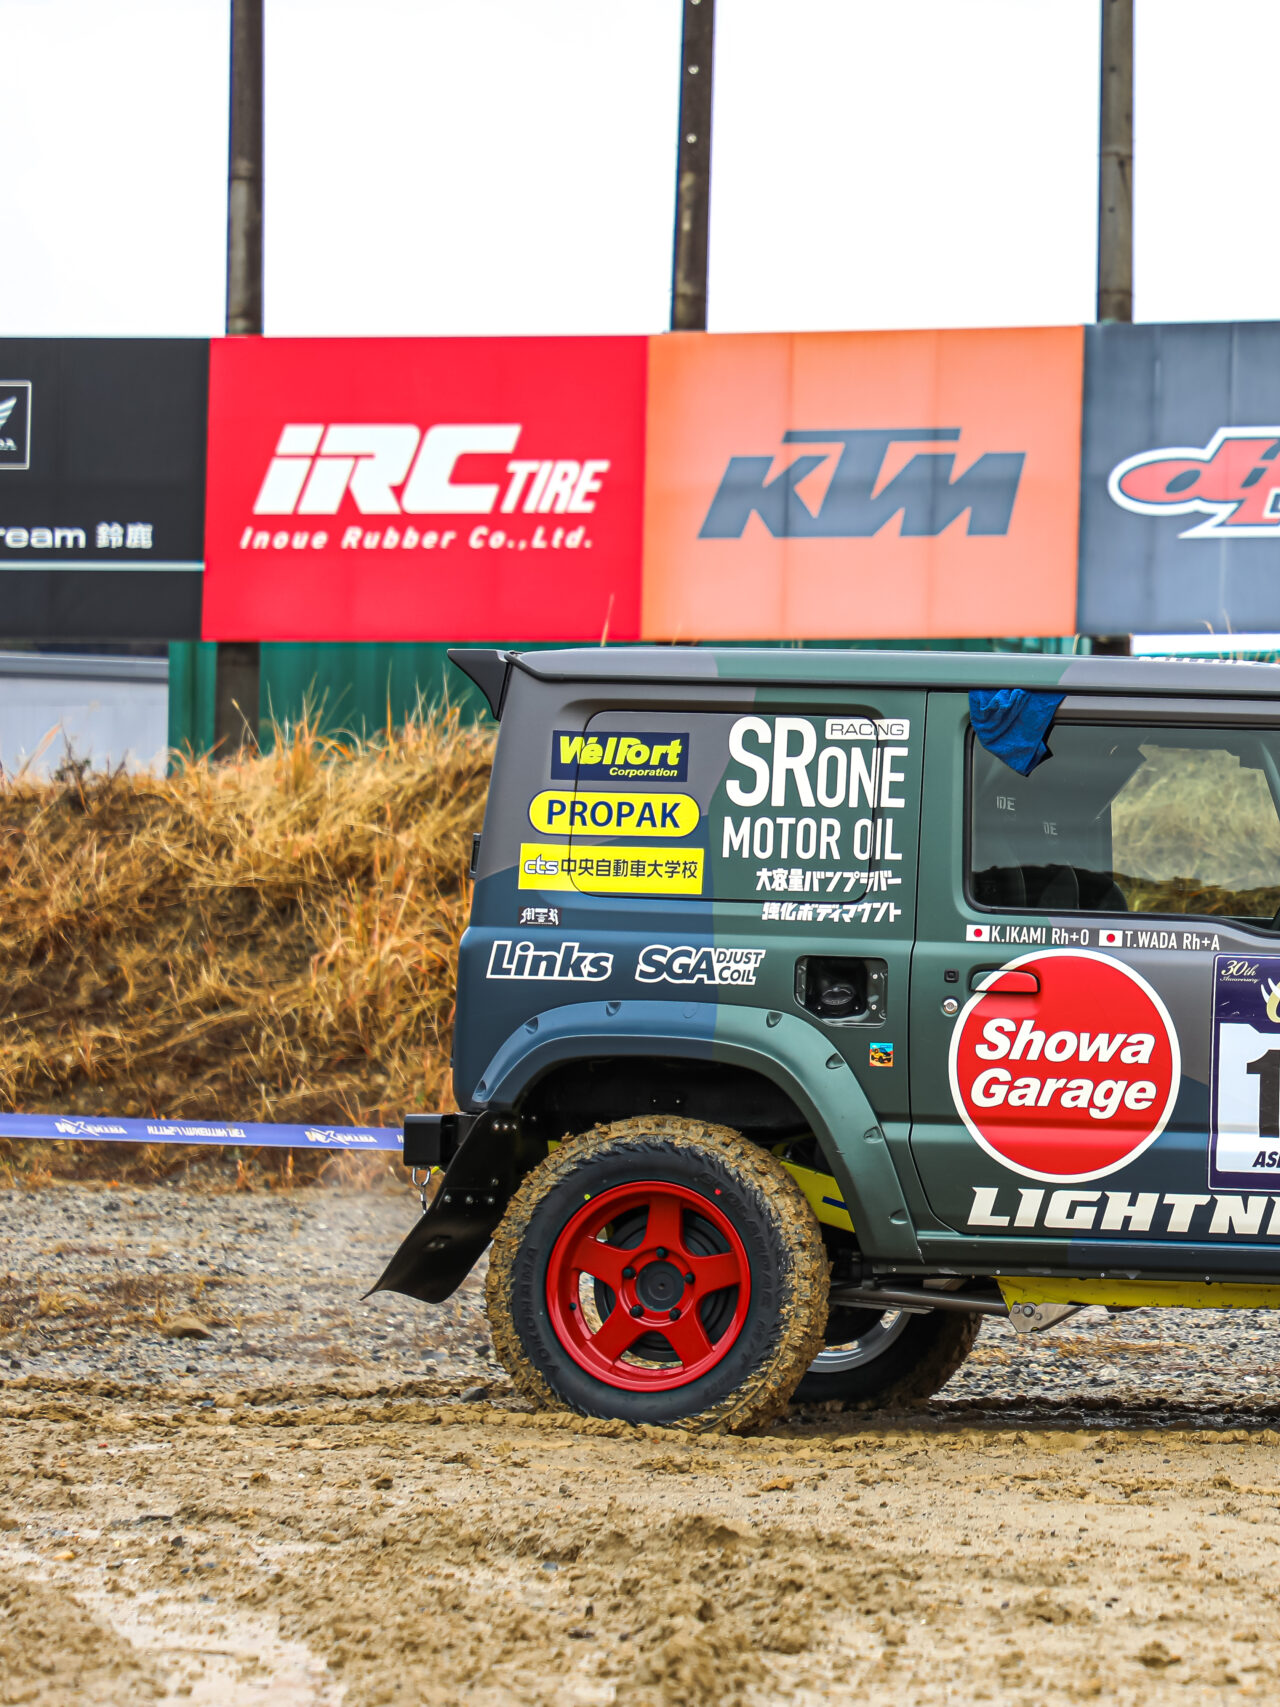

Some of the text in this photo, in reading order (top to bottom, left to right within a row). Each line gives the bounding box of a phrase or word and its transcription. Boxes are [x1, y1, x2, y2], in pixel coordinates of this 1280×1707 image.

[500, 459, 610, 514] TIRE
[696, 428, 1026, 539] KTM
[240, 525, 593, 551] Inoue Rubber Co.,Ltd.
[830, 723, 905, 736] RACING
[609, 767, 678, 778] Corporation
[547, 799, 681, 829] PROPAK
[722, 816, 903, 861] MOTOR OIL
[523, 853, 698, 879] cts 中央自動車大学校
[755, 868, 902, 892] 大容量バンプラバー
[761, 902, 902, 923] 強化ボディマウント
[991, 926, 1046, 944] K.IKAMI
[1125, 931, 1178, 949] T.WADA
[1183, 933, 1220, 951] Rh+A
[486, 941, 614, 981] Links
[1221, 960, 1259, 976] 30th
[975, 1018, 1155, 1064] Showa
[970, 1068, 1157, 1119] Garage
